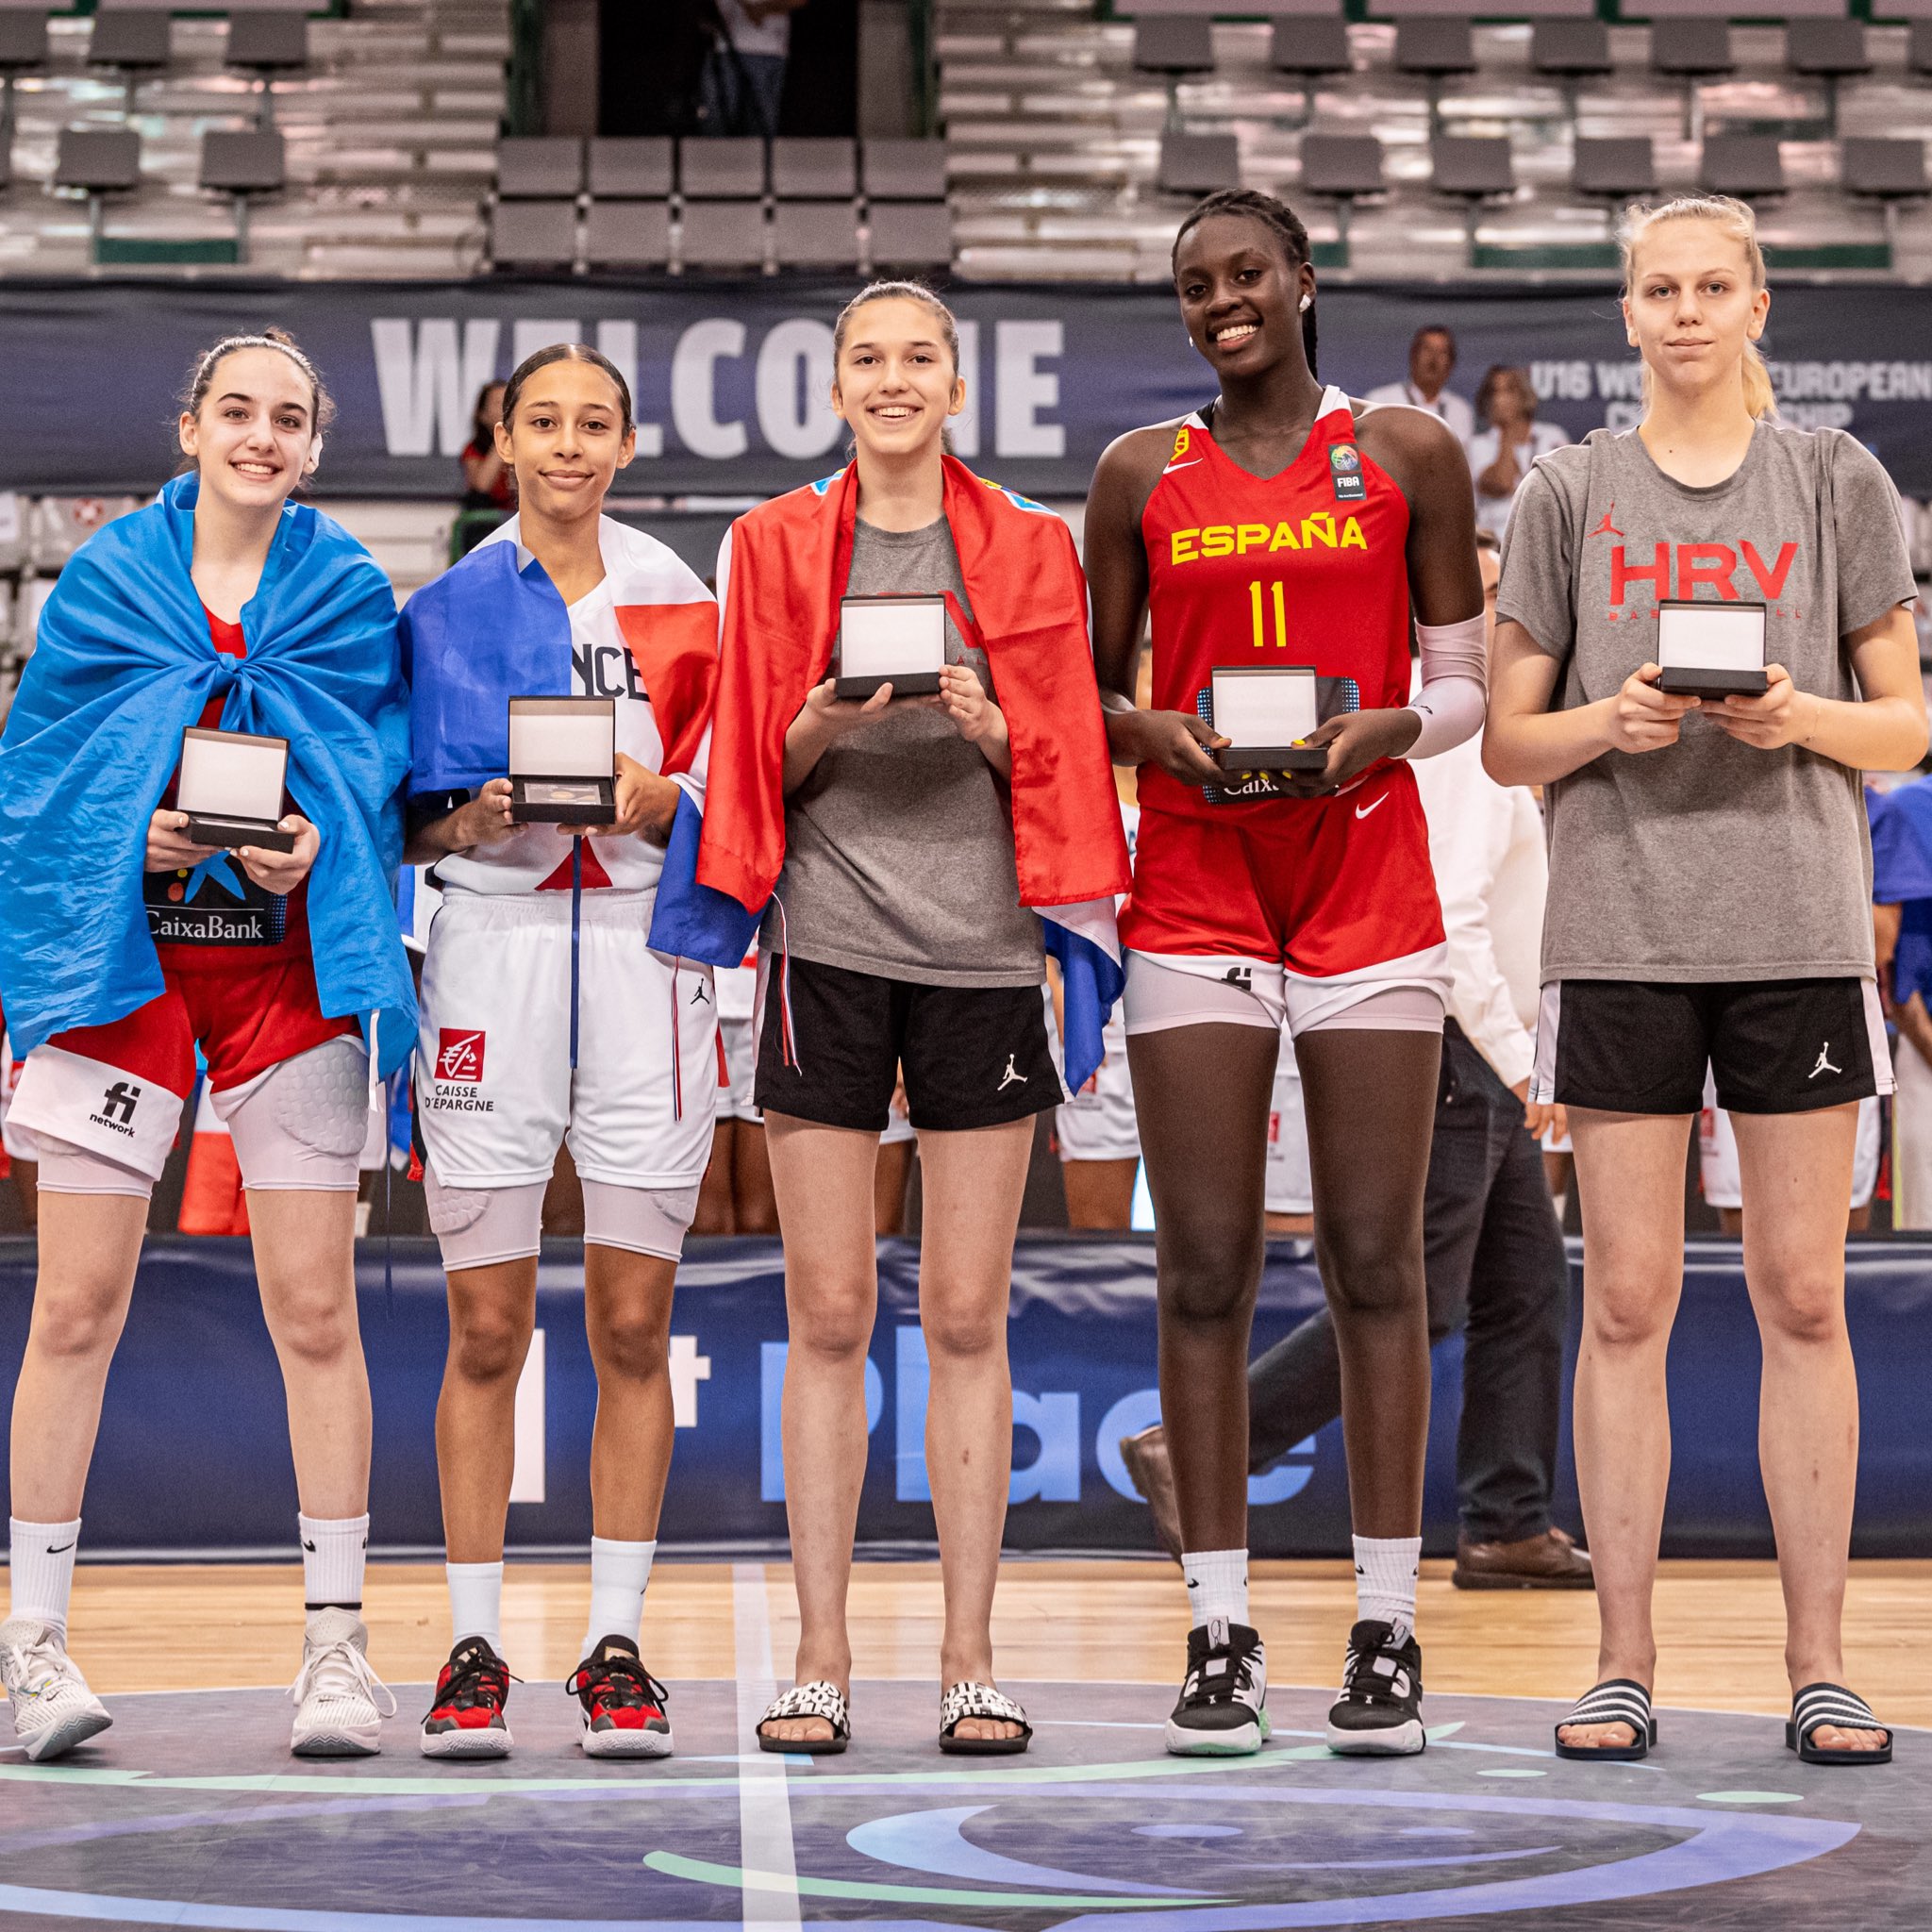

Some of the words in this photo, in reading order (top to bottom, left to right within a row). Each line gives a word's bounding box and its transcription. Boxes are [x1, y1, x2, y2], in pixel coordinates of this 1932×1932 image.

[371, 318, 1066, 459] WLCOE
[1530, 360, 1591, 401] U16
[1337, 476, 1359, 488] FIBA
[1171, 511, 1368, 566] ESPAÑA
[1609, 539, 1799, 606] HRV
[1249, 580, 1287, 648] 11
[145, 910, 265, 940] CaixaBank
[102, 1081, 142, 1124] fi
[435, 1085, 478, 1098] CAISSE
[89, 1113, 136, 1139] network
